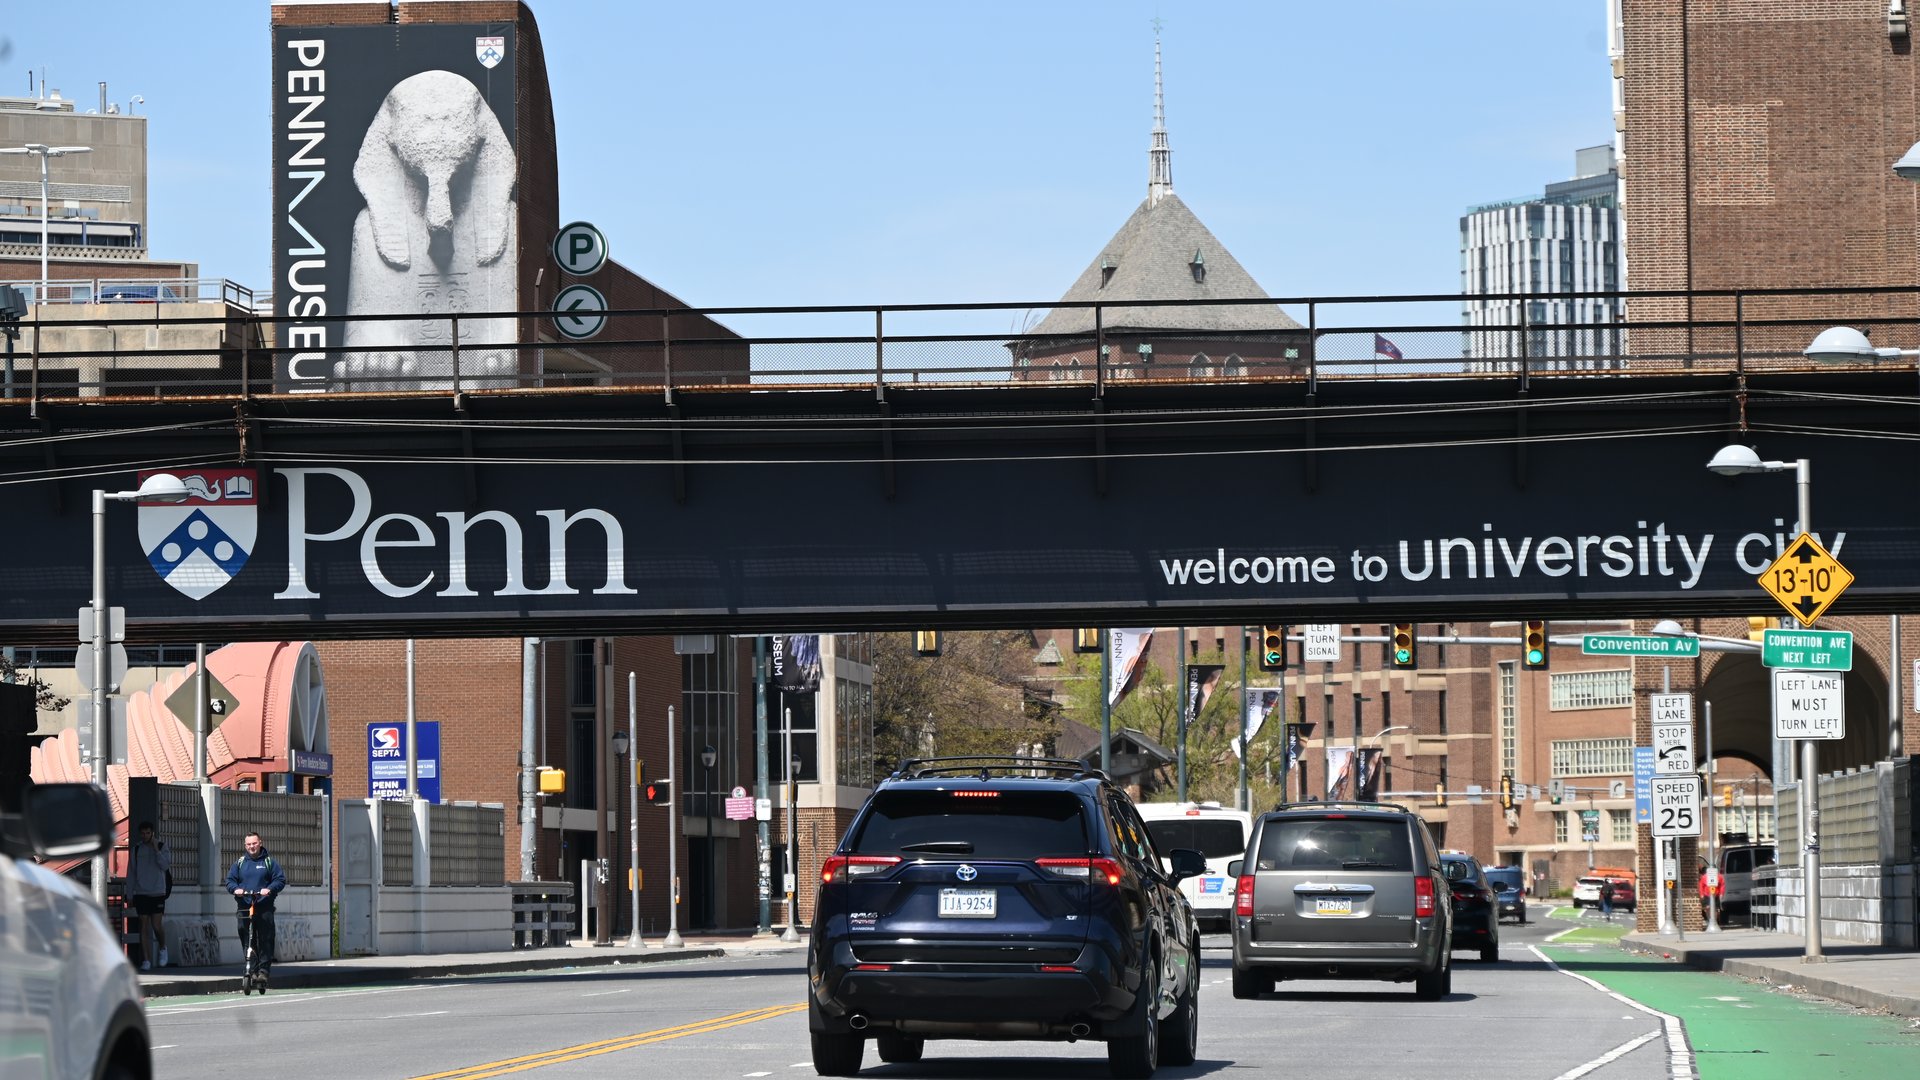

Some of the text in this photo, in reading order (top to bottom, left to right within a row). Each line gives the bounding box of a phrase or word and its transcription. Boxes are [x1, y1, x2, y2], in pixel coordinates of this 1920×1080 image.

[570, 233, 594, 266] P
[274, 467, 638, 600] Penn
[1160, 548, 1336, 585] welcome
[1350, 549, 1388, 582] to
[1400, 520, 1714, 589] university
[1774, 566, 1836, 594] 13'-10"
[1310, 635, 1335, 644] TURN
[1589, 638, 1692, 652] Convention Av
[1768, 635, 1846, 648] CONVENTION AVE
[1308, 647, 1337, 656] SIGNAL
[1782, 652, 1831, 664] NEXT LEFT
[1782, 680, 1838, 690] LEFT LANE
[1658, 698, 1684, 708] LEFT
[1792, 698, 1828, 710] MUST
[1658, 710, 1686, 720] LANE
[1782, 718, 1838, 730] TURN LEFT
[1658, 728, 1686, 738] STOP
[372, 750, 400, 758] SEPTA
[1668, 760, 1690, 770] RED
[372, 781, 398, 789] PENN
[1656, 783, 1694, 794] SPEED
[1660, 795, 1690, 804] LIMIT
[1660, 808, 1693, 830] 25
[943, 897, 992, 910] TJA-9254
